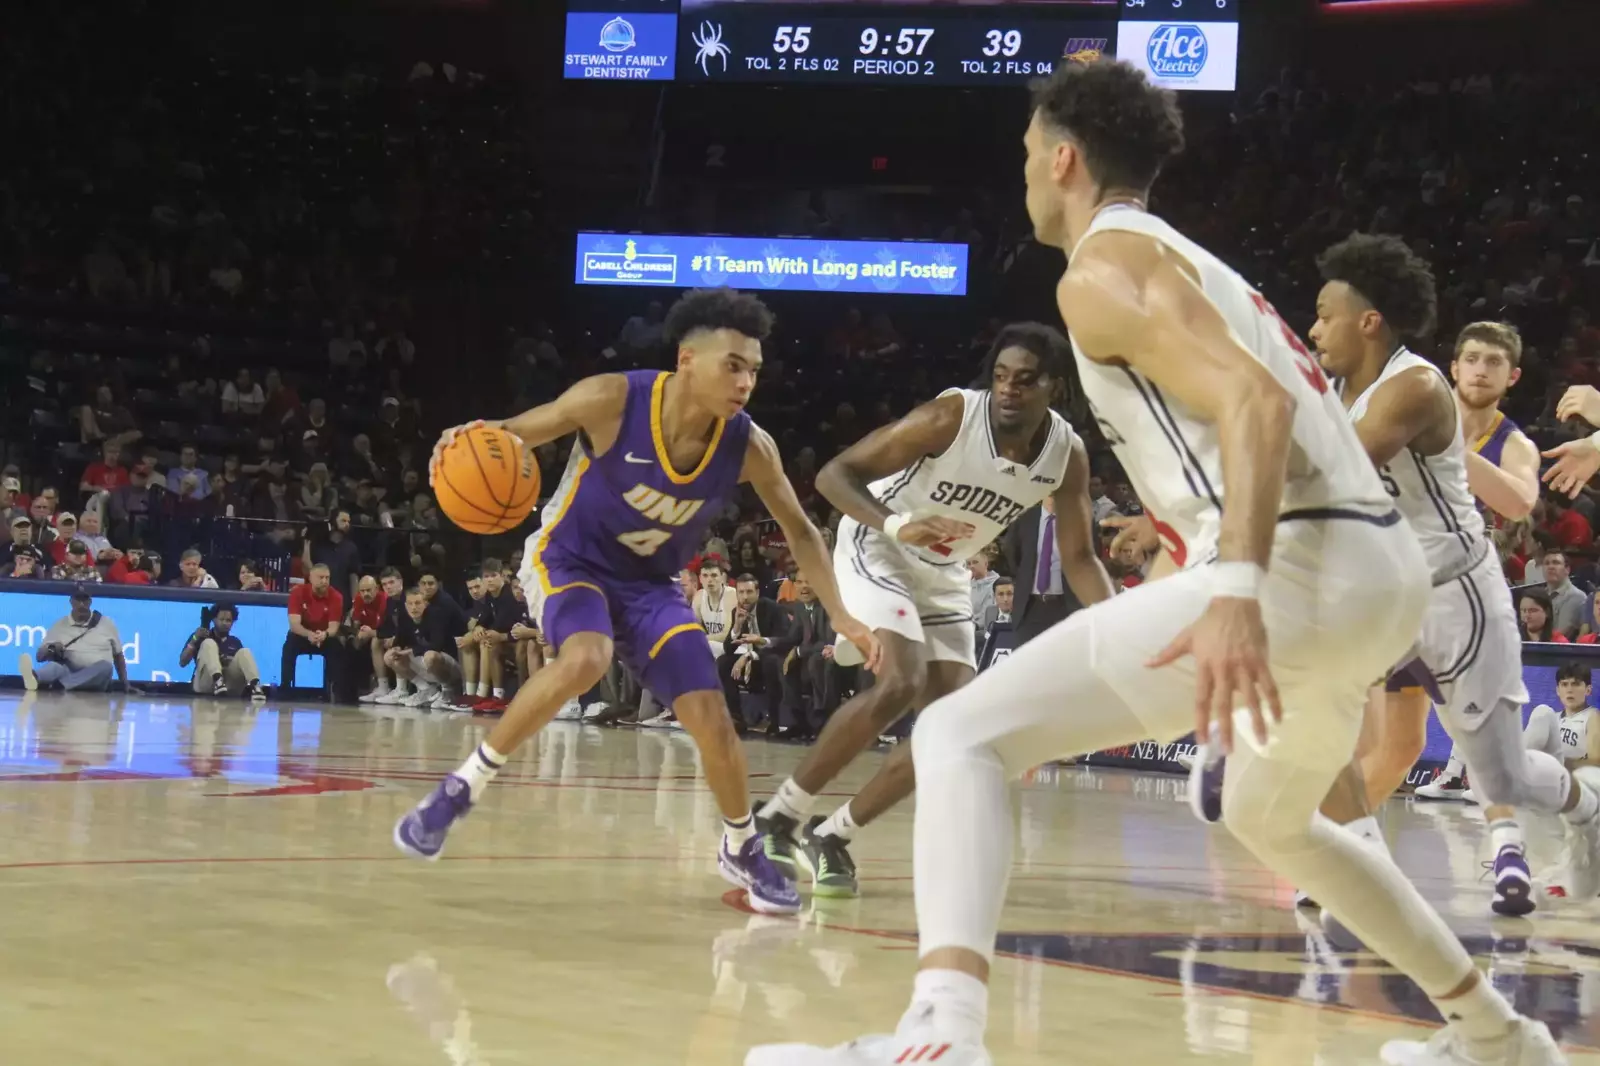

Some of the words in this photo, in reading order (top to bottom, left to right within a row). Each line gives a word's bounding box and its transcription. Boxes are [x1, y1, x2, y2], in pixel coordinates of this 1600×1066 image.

[773, 26, 811, 53] 55
[859, 28, 935, 55] 9:57
[982, 29, 1022, 57] 39
[1064, 37, 1108, 54] UNI
[1150, 26, 1204, 62] Ace
[565, 54, 623, 65] STEWART
[625, 55, 668, 66] FAMILY
[745, 57, 772, 70] TOL
[778, 58, 787, 70] 2
[794, 58, 819, 71] FLS
[823, 59, 839, 71] 02
[854, 59, 919, 75] PERIOD
[924, 61, 935, 75] 2
[961, 60, 987, 73] TOL
[993, 61, 1001, 74] 2
[1006, 61, 1032, 74] FLS
[1036, 62, 1053, 75] 04
[1154, 58, 1200, 73] Electric
[584, 67, 651, 79] DENTISTRY
[691, 256, 712, 271] #1
[716, 256, 764, 273] Team
[767, 257, 808, 275] With
[813, 258, 858, 280] Long
[862, 260, 896, 277] and
[900, 261, 958, 279] Foster
[622, 482, 706, 527] UNI
[616, 528, 673, 556] 4
